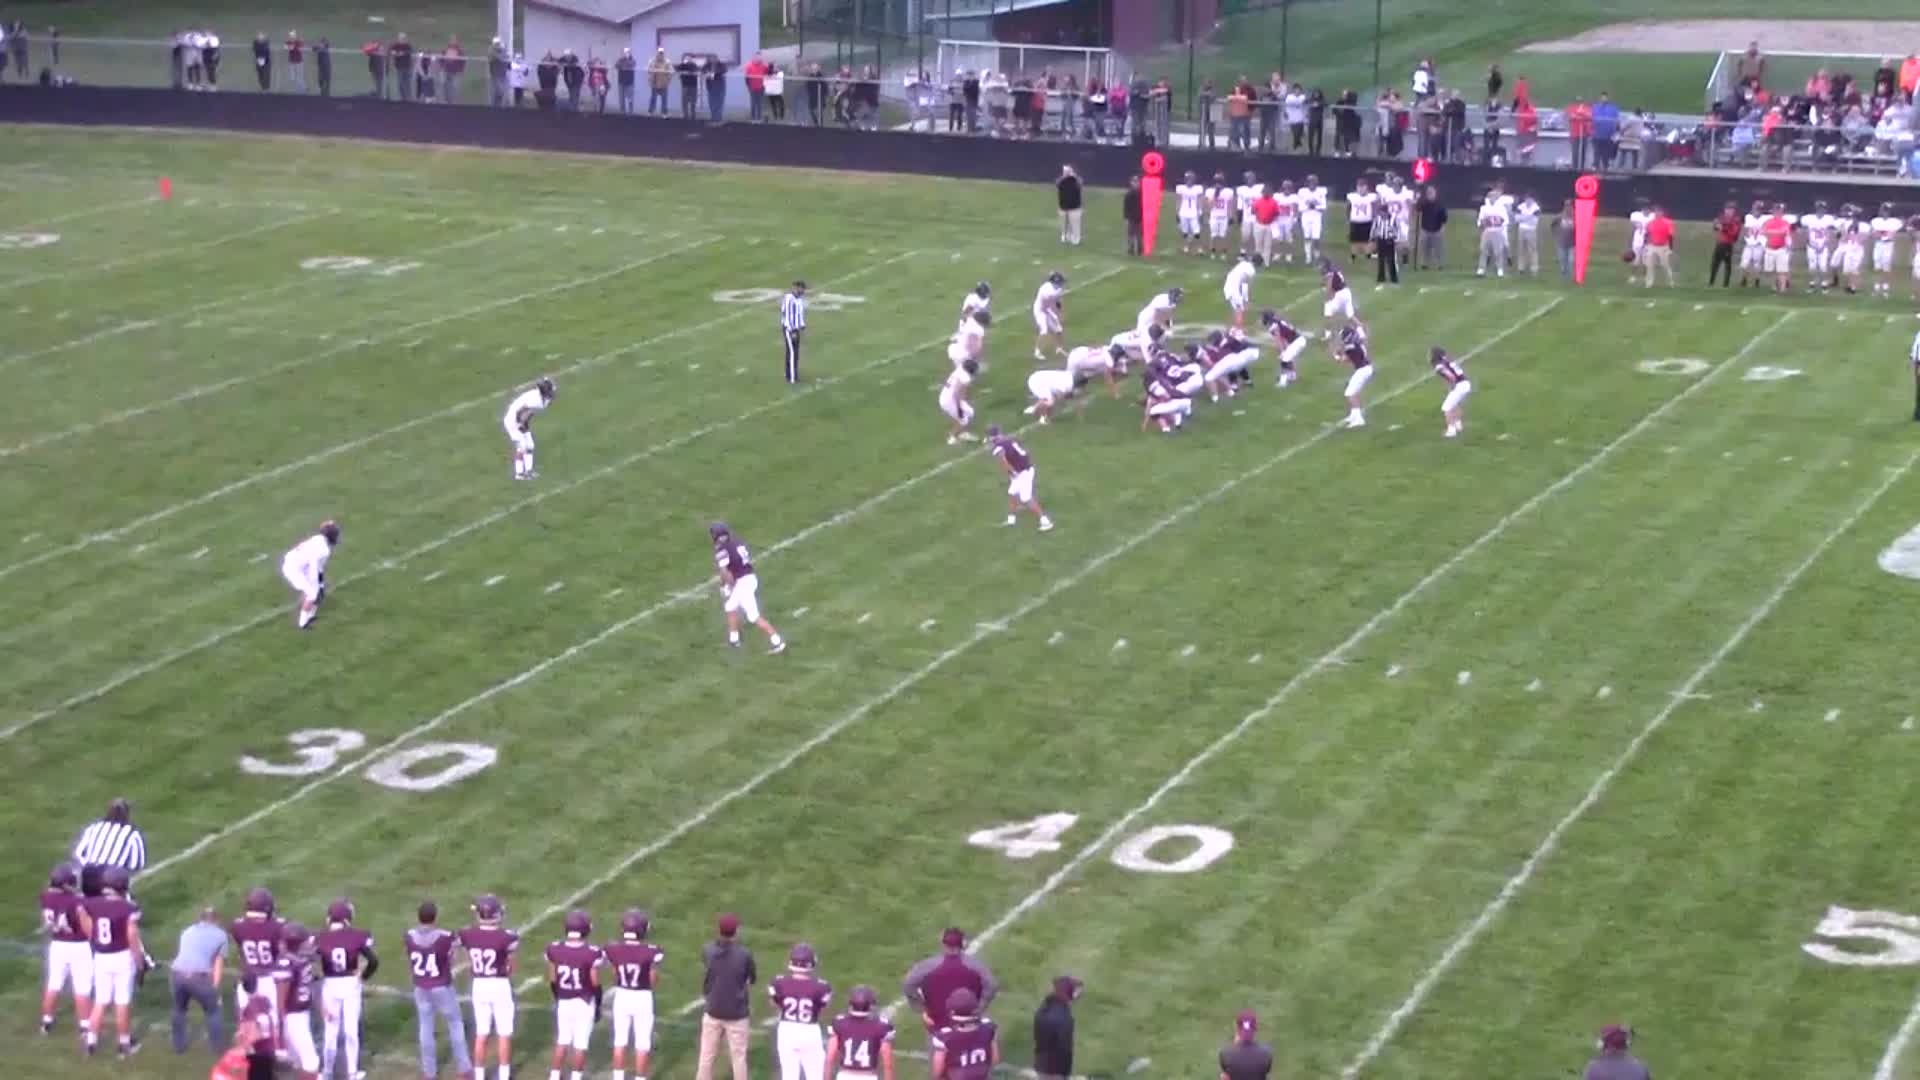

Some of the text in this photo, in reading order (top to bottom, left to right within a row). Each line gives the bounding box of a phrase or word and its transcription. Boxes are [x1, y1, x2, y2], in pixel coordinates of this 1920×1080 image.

[238, 727, 498, 791] 30
[967, 811, 1235, 873] 40
[97, 917, 112, 945] 8
[242, 940, 273, 966] 66
[410, 951, 441, 978] 24
[469, 949, 498, 977] 82
[557, 965, 584, 991] 21
[616, 963, 641, 989] 17
[782, 996, 813, 1023] 26
[842, 1037, 871, 1068] 14
